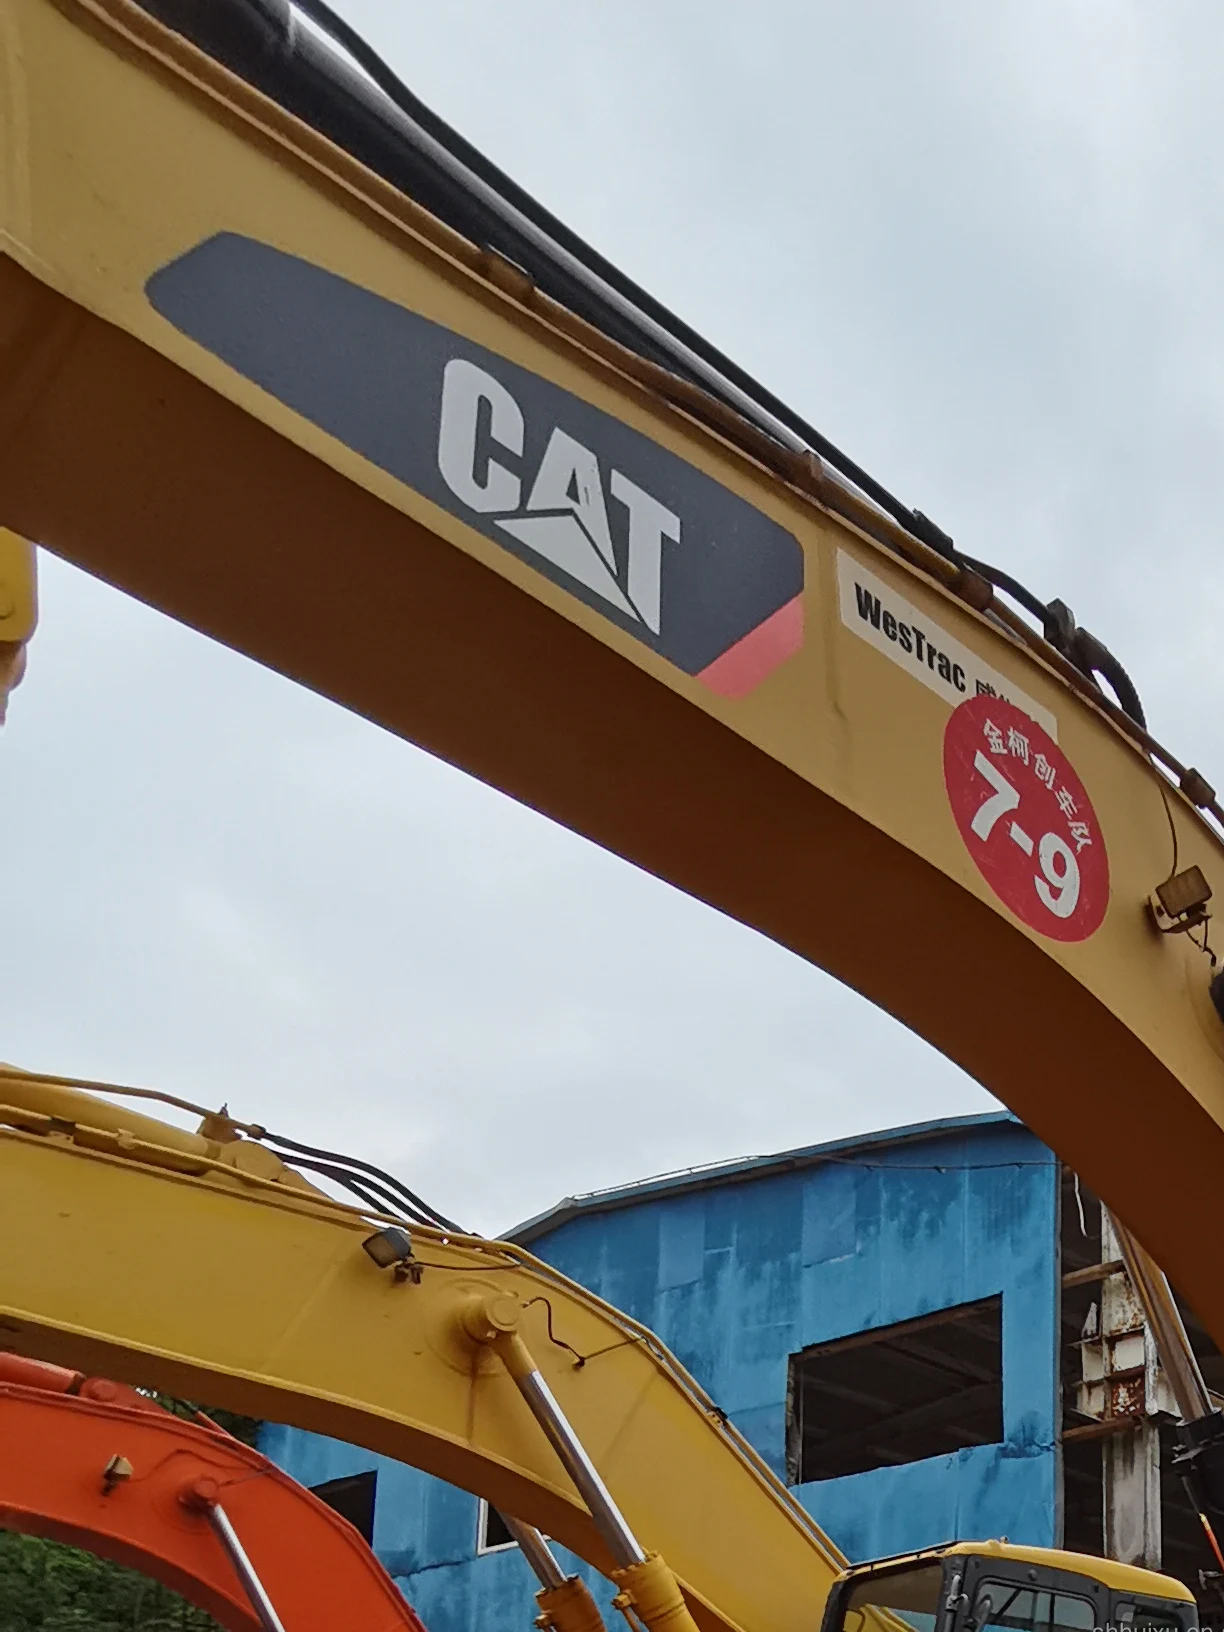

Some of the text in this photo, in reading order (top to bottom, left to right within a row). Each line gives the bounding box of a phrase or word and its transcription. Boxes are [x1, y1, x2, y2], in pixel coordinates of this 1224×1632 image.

[439, 358, 681, 636] CAT
[854, 582, 965, 693] WesTrac
[971, 750, 1080, 918] 7-9
